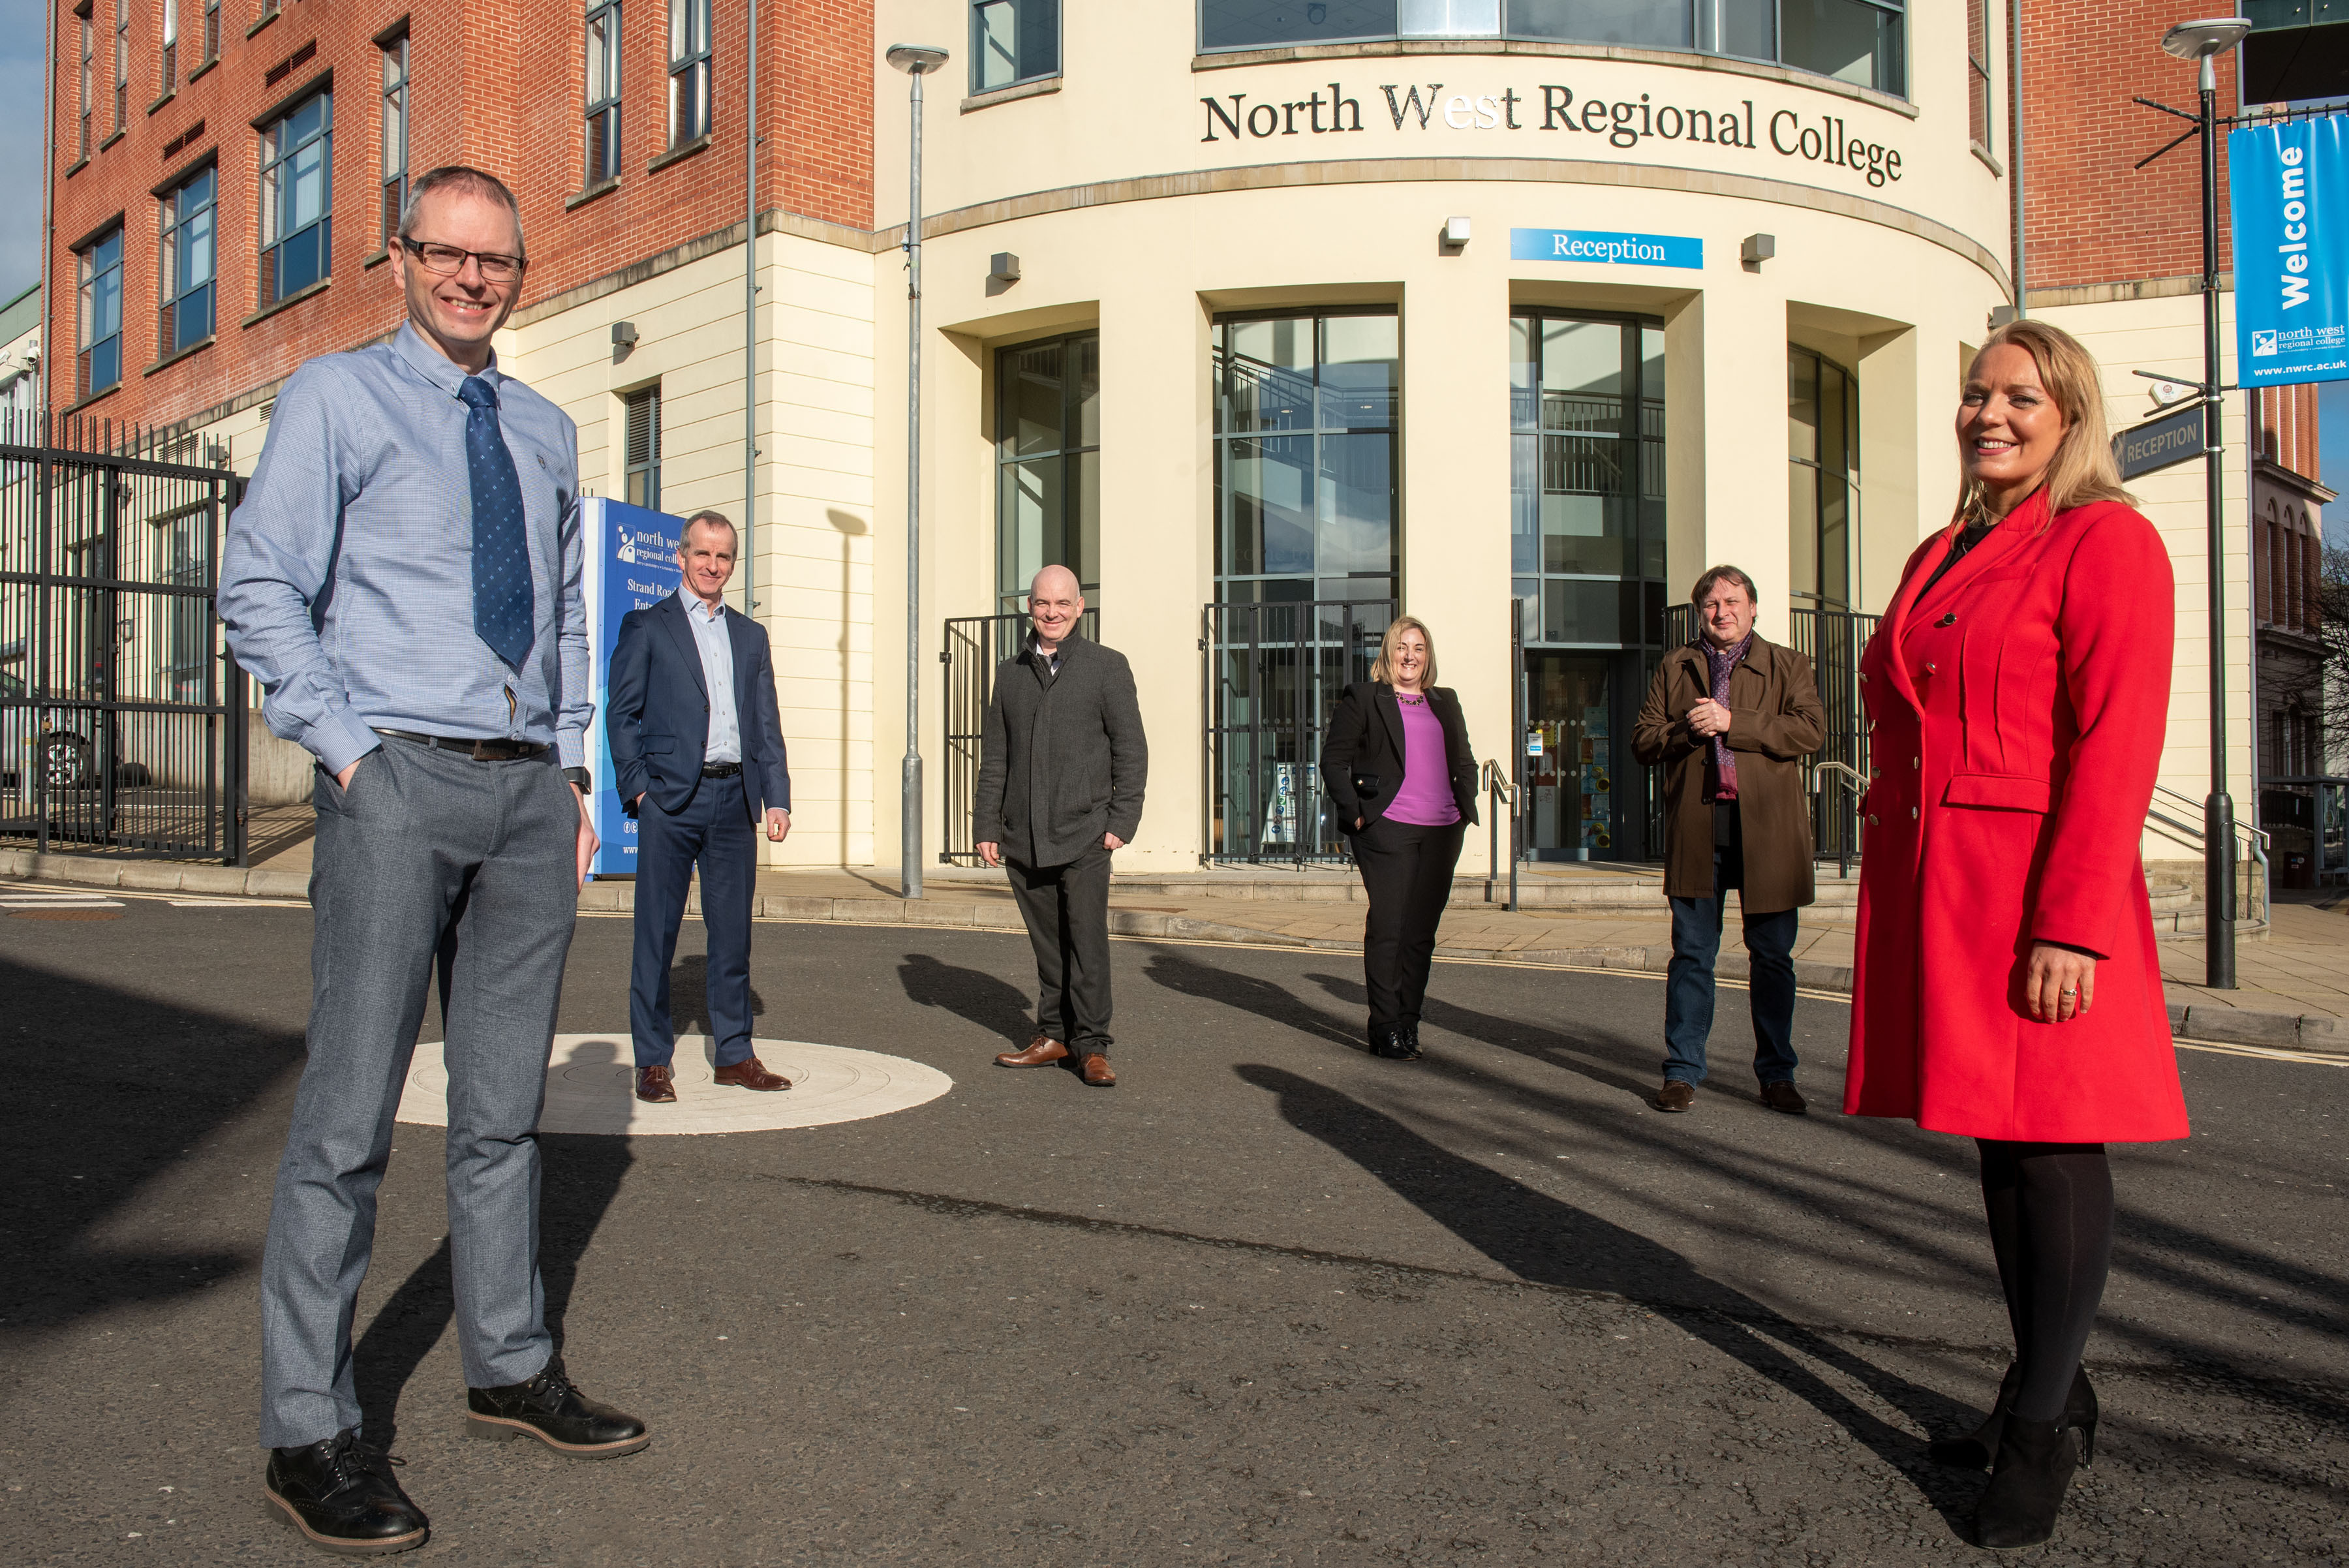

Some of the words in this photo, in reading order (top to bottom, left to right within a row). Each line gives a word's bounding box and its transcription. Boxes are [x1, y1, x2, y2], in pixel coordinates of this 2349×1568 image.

[1200, 83, 1364, 143] North
[1379, 84, 1522, 131] West
[1538, 84, 1757, 148] Regional
[1769, 110, 1903, 188] College
[2279, 147, 2310, 311] Welcome
[1552, 234, 1666, 263] Reception
[2279, 326, 2312, 340] north
[2316, 324, 2345, 335] west
[2279, 338, 2314, 350] regional
[2316, 336, 2346, 345] college
[2254, 360, 2347, 377] www.nwrc.ac.uk
[2127, 423, 2197, 463] RECEPTION
[637, 530, 664, 547] north
[666, 538, 679, 550] we
[636, 548, 664, 561] regional
[665, 553, 679, 564] coll
[628, 578, 654, 595] Strand
[634, 598, 653, 610] Entr
